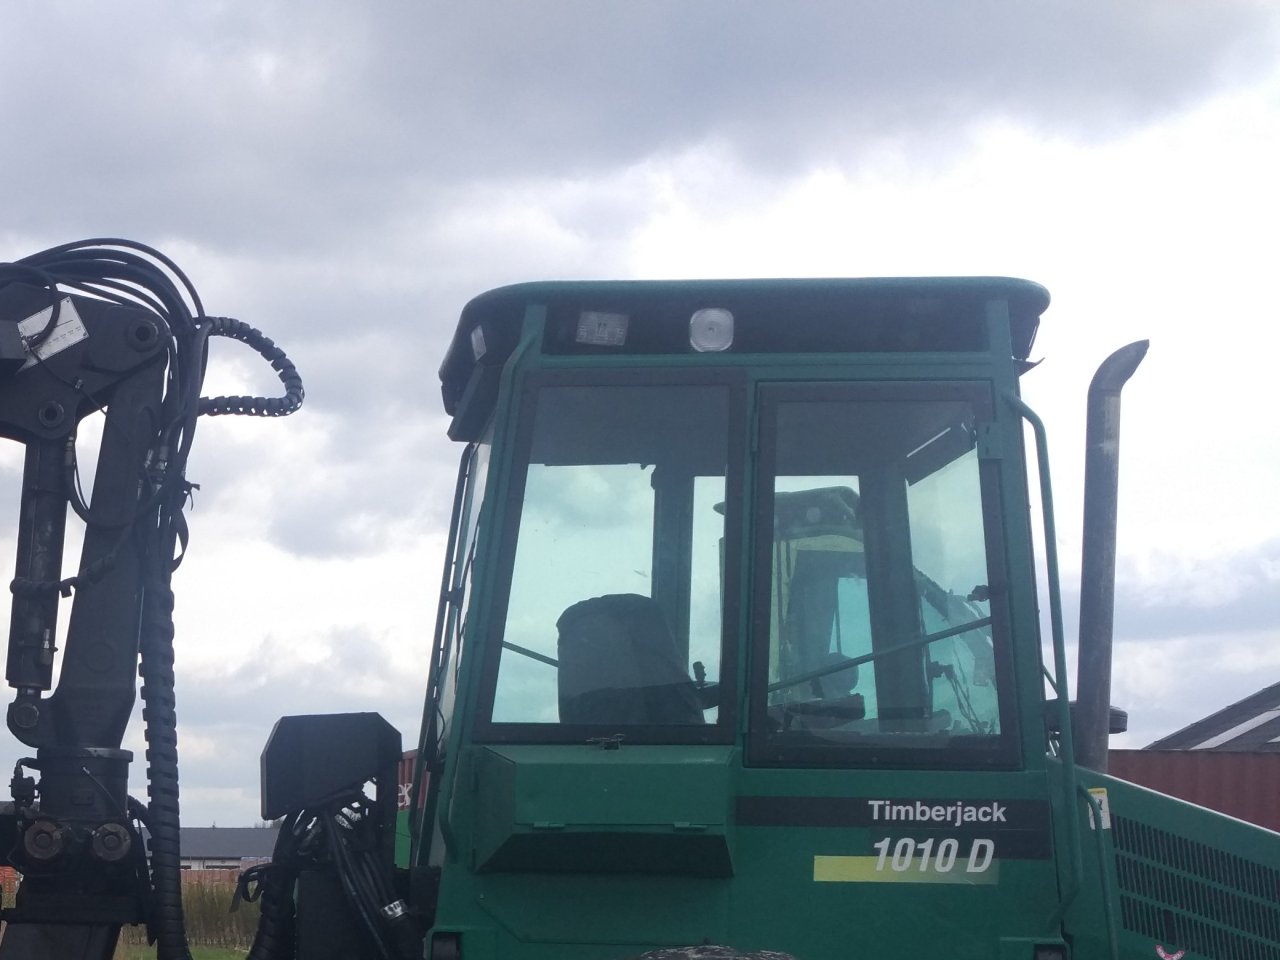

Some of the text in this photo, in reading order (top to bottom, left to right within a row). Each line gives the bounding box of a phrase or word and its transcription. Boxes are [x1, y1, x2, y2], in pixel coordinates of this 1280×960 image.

[868, 800, 1007, 826] Timberjack
[873, 837, 995, 873] 1010 D
